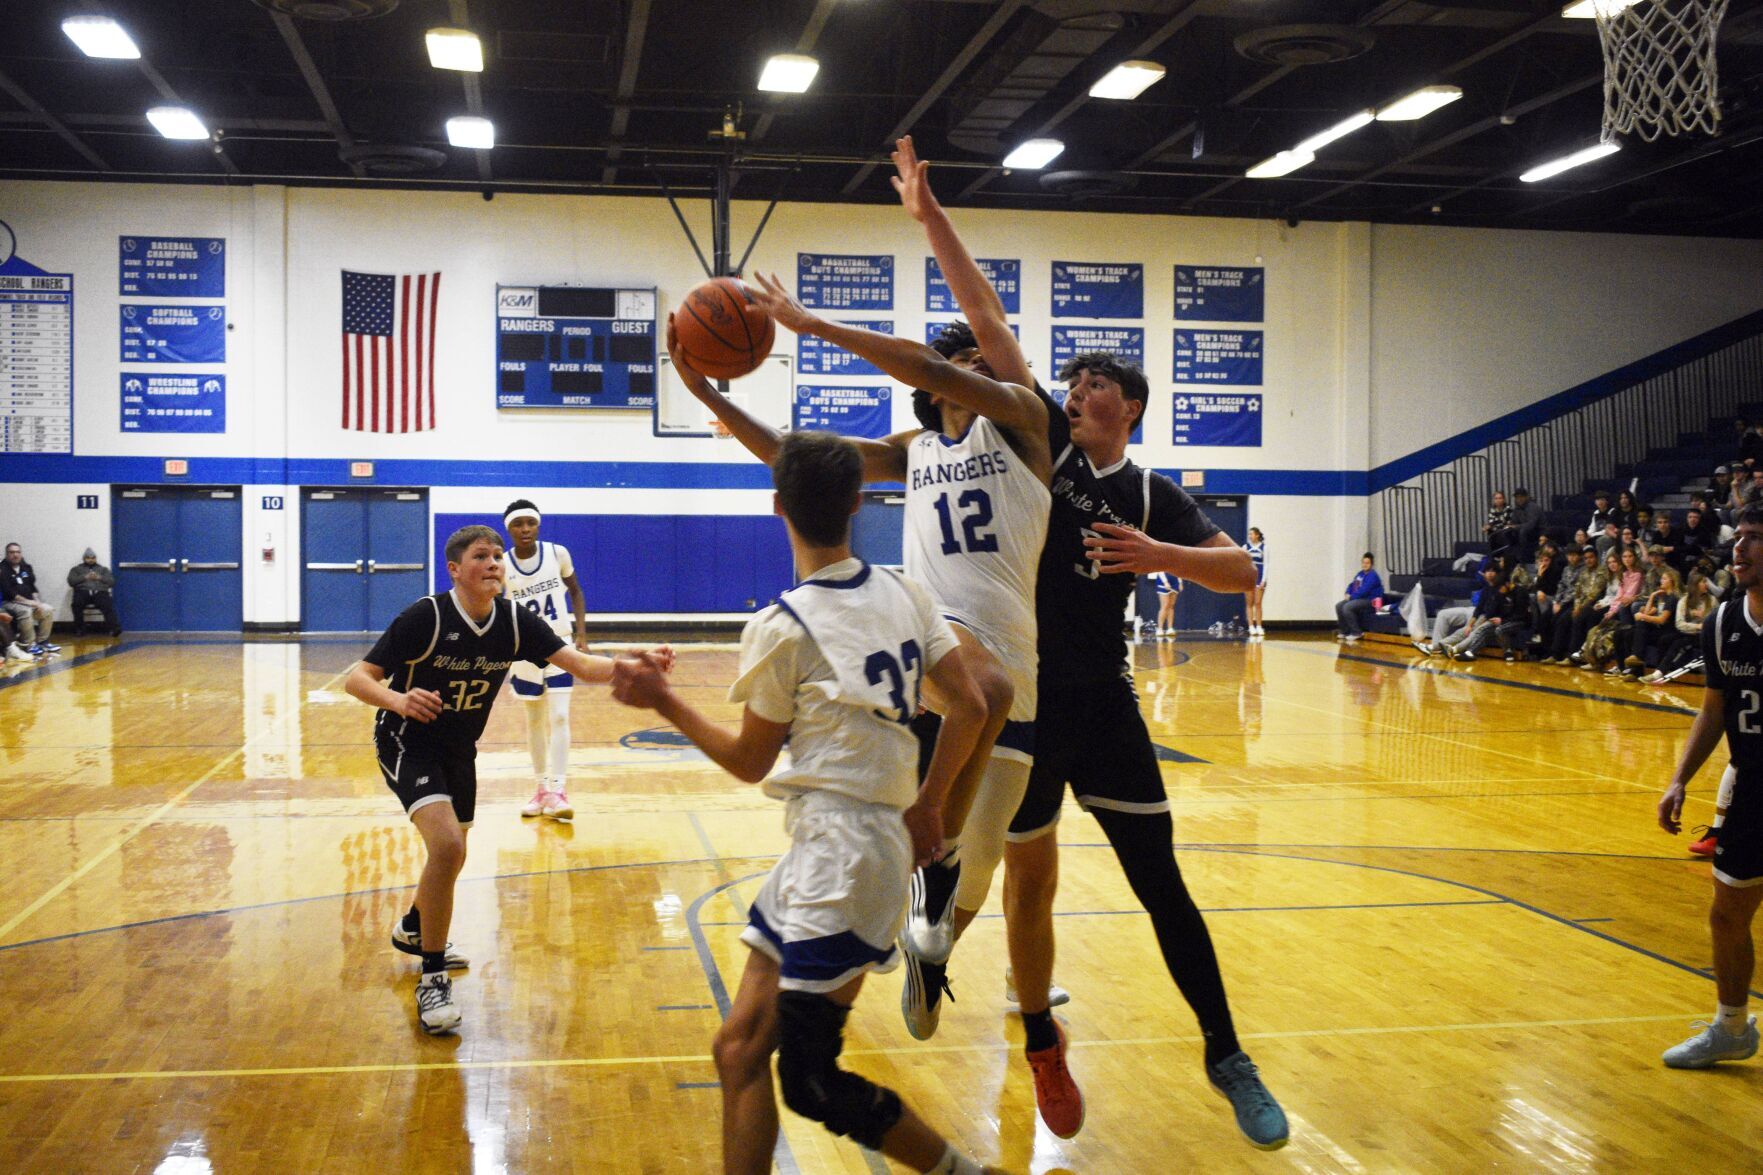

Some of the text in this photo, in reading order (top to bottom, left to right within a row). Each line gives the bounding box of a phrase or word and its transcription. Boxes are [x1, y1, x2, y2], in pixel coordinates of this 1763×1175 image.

[151, 242, 193, 250] BASEBALL
[146, 250, 198, 259] CHAMPIONS
[822, 258, 870, 266] BASKETBALL
[811, 266, 881, 275] BOYS CHAMPIONS
[1066, 266, 1128, 275] WOMEN'S TRACK
[1075, 274, 1120, 283] CHAMPIONS
[1197, 278, 1241, 286] CHAMPIONS
[32, 278, 63, 289] RANGERS
[500, 295, 533, 307] K&M
[152, 309, 193, 317] SOFTBALL
[146, 317, 198, 325] CHAMPIONS
[501, 319, 649, 333] RANGERS GUEST
[562, 327, 591, 336] PERIOD
[1067, 330, 1128, 339] WOMEN'S TRACK
[1194, 334, 1218, 342] MEN'S
[1196, 342, 1240, 350] CHAMPIONS
[500, 362, 653, 373] FOULS PLAYER FOUL FOULS
[148, 378, 198, 386] WRESTLING
[147, 387, 199, 395] CHAMPIONS
[820, 389, 868, 397] BASKETBALL
[499, 395, 653, 406] SCORE MATCH SCORE
[810, 397, 879, 406] BOYS CHAMPIONS
[1216, 397, 1245, 405] SOCCER
[1196, 405, 1240, 413] CHAMPIONS
[169, 462, 183, 472] EXIT
[355, 464, 369, 474] EXIT
[912, 450, 1008, 490] RANGERS
[80, 497, 95, 507] 11
[264, 498, 281, 509] 10
[933, 488, 999, 555] 12
[512, 578, 559, 600] RANGERS
[433, 655, 471, 670] White
[1720, 660, 1756, 677] White
[443, 680, 490, 712] 32
